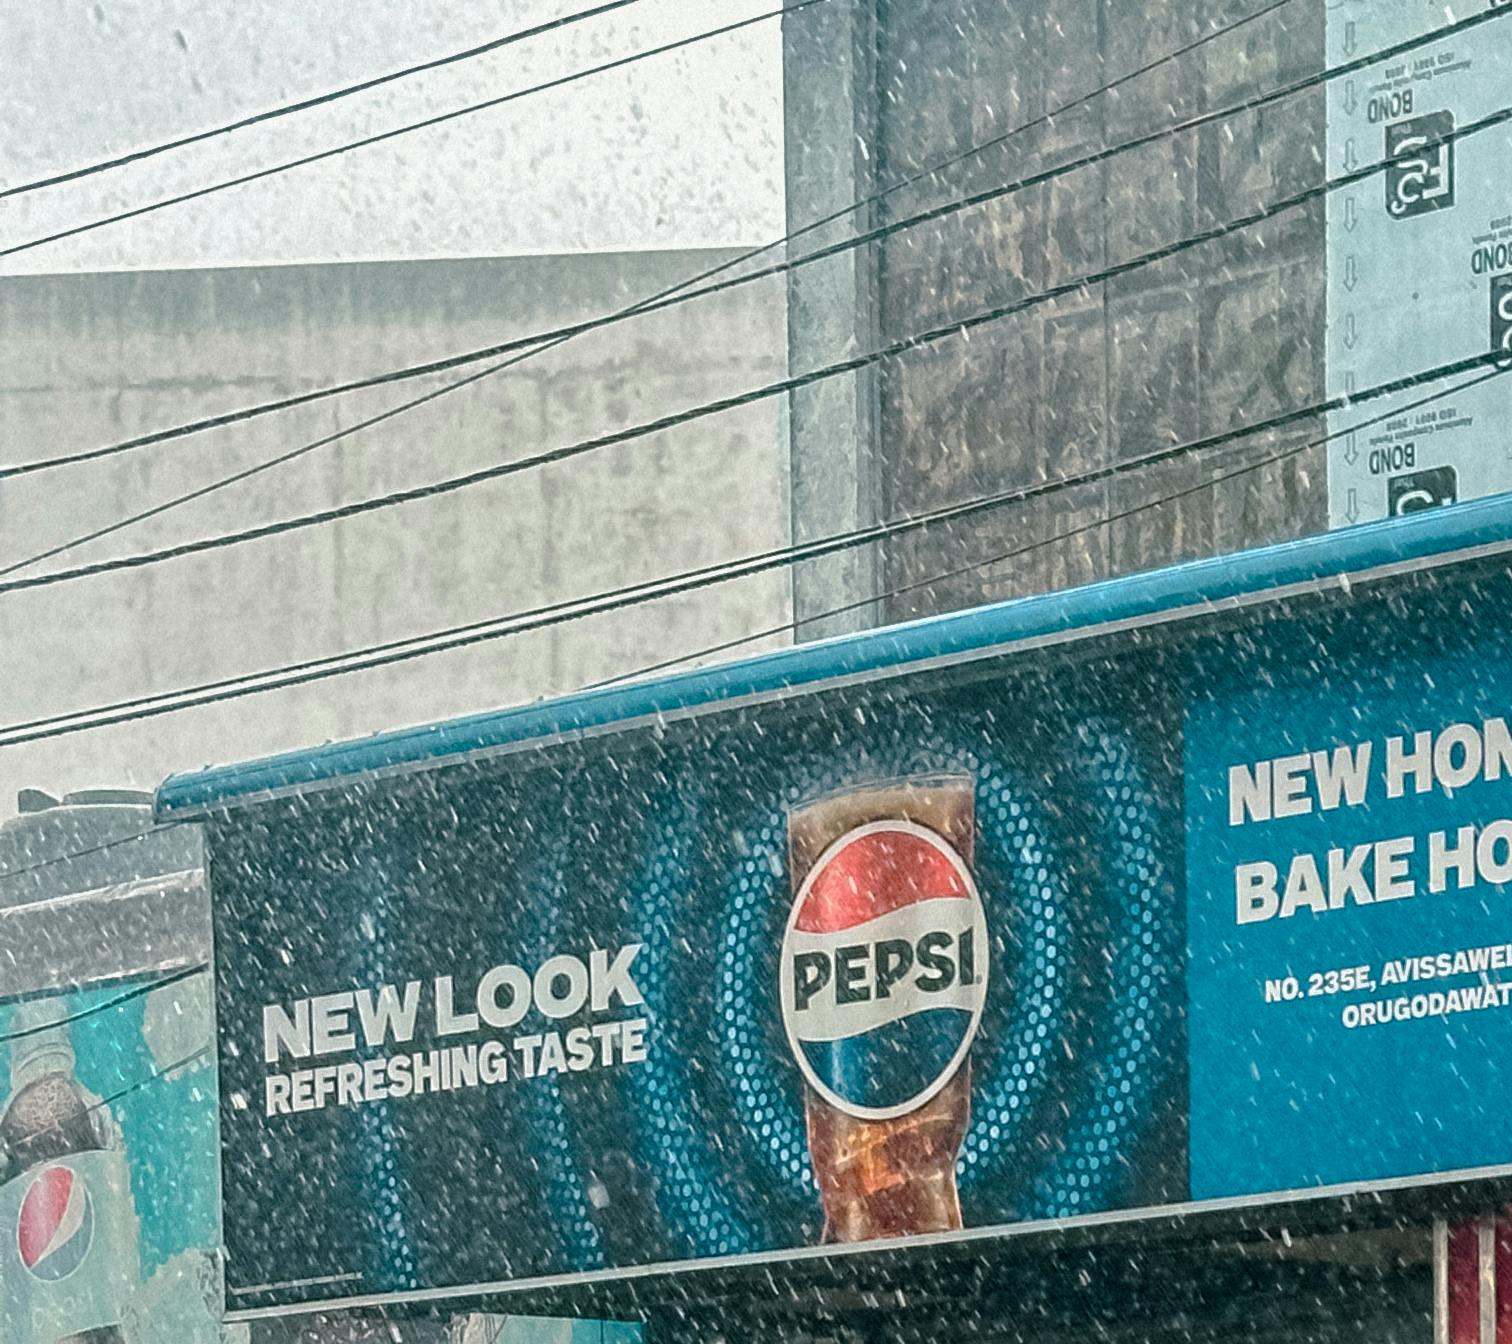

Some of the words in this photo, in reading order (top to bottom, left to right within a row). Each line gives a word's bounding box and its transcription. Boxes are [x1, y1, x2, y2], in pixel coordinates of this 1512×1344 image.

[1368, 89, 1412, 123] BOND
[1369, 443, 1415, 474] BOND
[1229, 742, 1372, 826] NEW
[1235, 837, 1415, 925] BAKE
[263, 981, 426, 1063] NEW
[433, 944, 647, 1035] LOOK
[794, 930, 977, 1012] PEPSI
[1265, 977, 1303, 1002] NO.
[1309, 966, 1377, 995] 235E,
[265, 1047, 507, 1117] REFRESHING
[513, 1019, 647, 1079] TASTE
